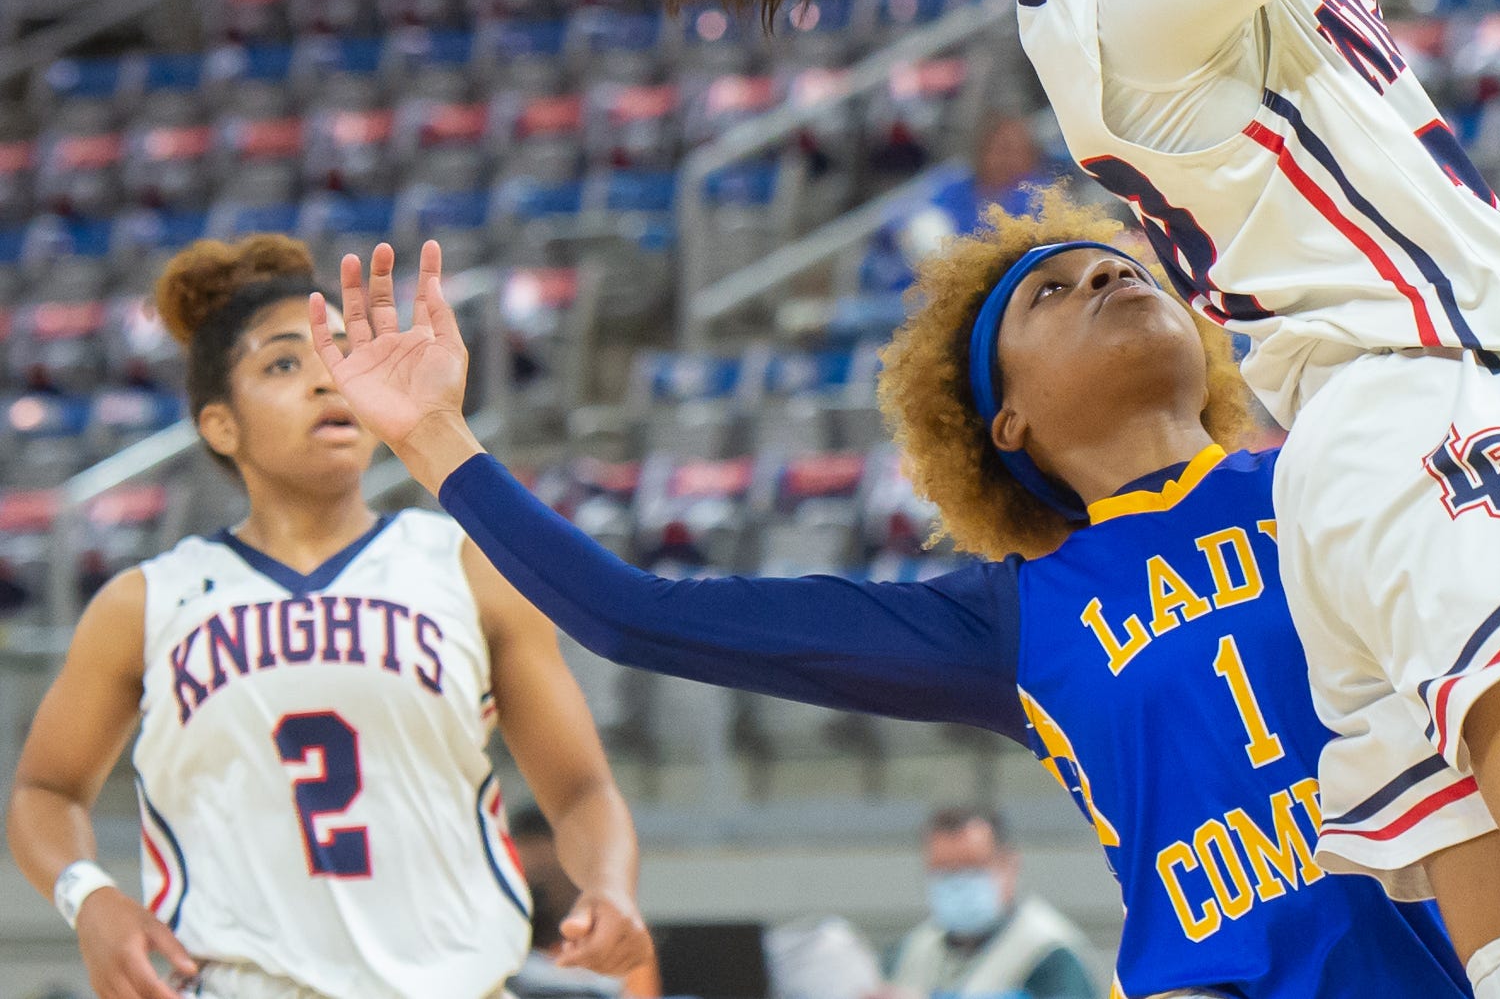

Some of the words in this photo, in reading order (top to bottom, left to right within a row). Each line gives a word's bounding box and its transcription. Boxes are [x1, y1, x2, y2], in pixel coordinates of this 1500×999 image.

[168, 594, 445, 726] KNIGHTS
[1212, 634, 1286, 769] 1
[272, 710, 373, 880] 2
